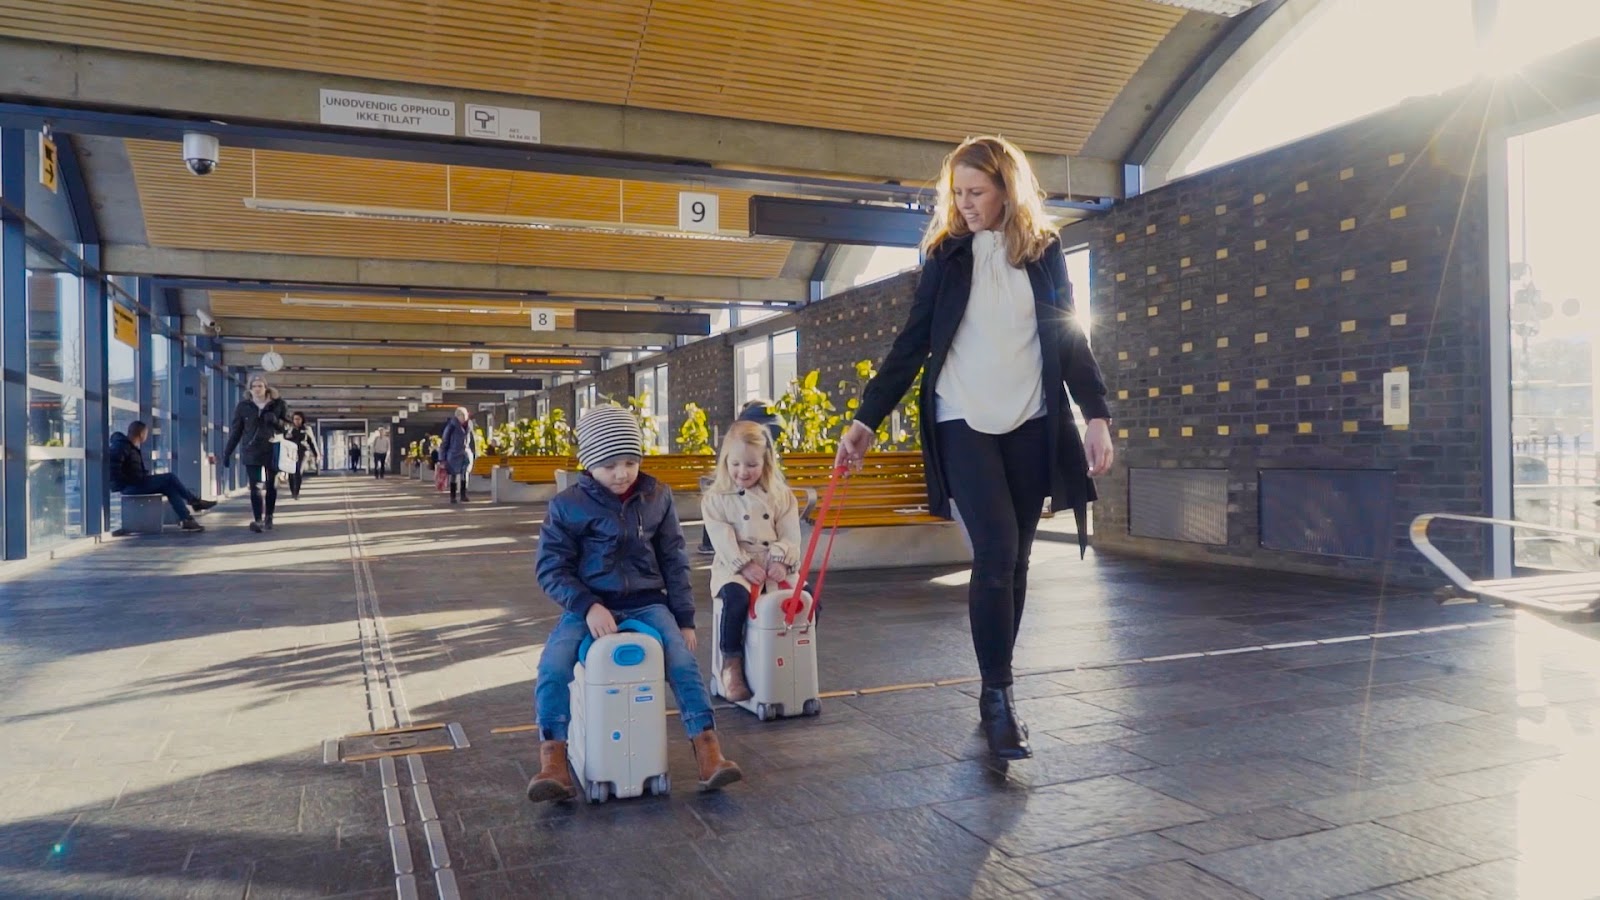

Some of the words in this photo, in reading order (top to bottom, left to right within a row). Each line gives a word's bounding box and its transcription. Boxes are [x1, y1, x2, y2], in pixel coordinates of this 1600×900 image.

[325, 96, 398, 112] UNØDVENDIG
[400, 103, 450, 117] OPPHOLD
[356, 111, 380, 122] IKKE
[382, 113, 421, 126] TILLATT
[691, 201, 706, 223] 9
[538, 313, 548, 326] 8
[478, 356, 484, 366] 7
